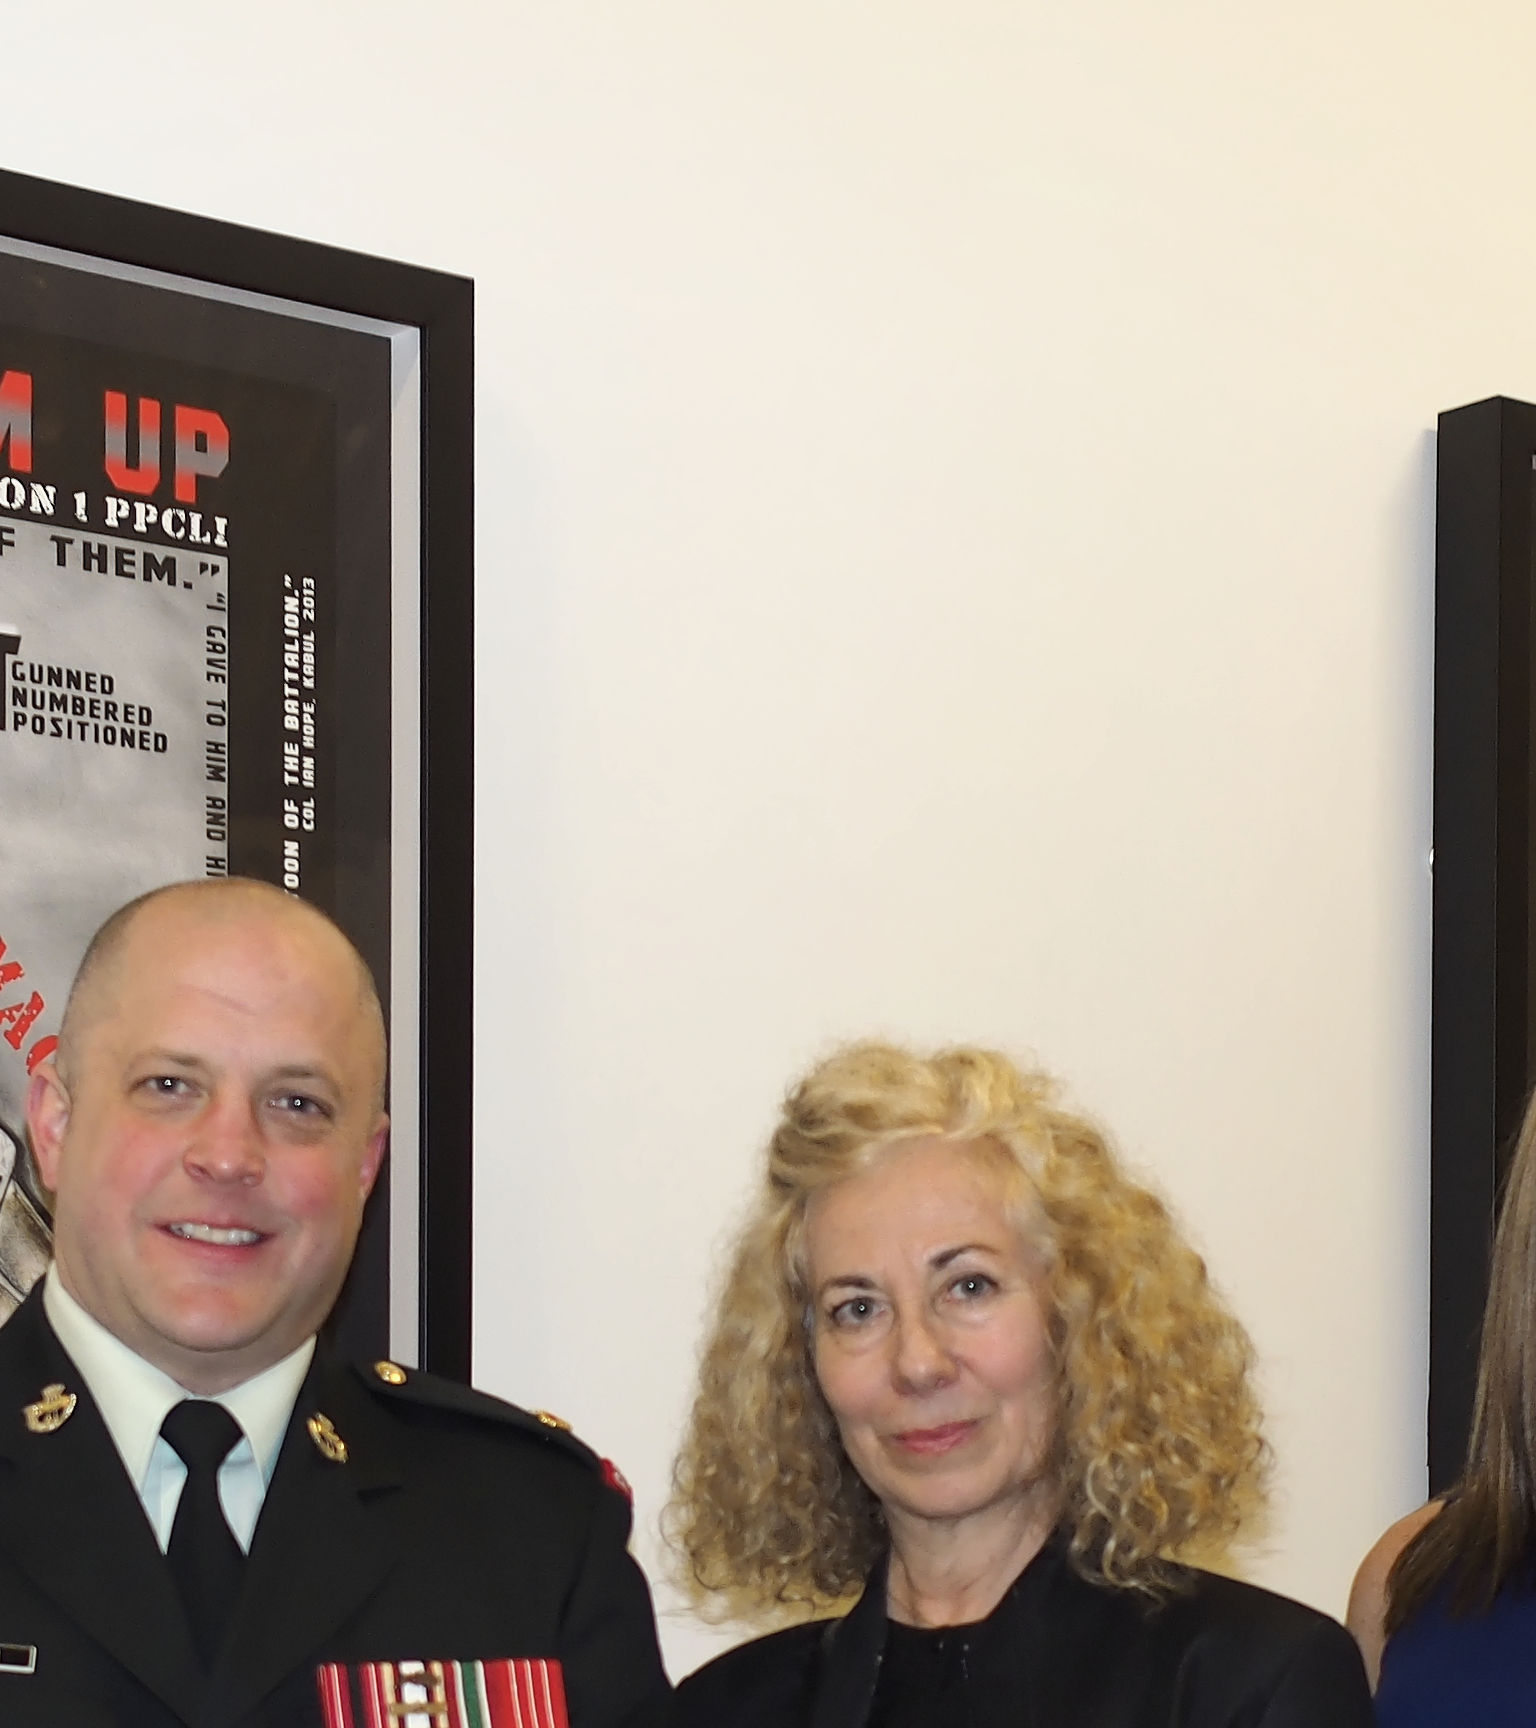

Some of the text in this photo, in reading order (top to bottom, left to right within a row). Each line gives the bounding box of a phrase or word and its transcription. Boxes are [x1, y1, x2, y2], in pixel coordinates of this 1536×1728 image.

[73, 491, 88, 523] 1
[104, 495, 228, 548] PPCLI
[205, 625, 226, 685] GAVE
[11, 660, 114, 696] GUNNED
[12, 685, 153, 728] NUMBERED
[205, 699, 226, 727] TO
[302, 576, 316, 830] COL IAN HOPE, KABUL 2013
[12, 712, 168, 754] POSITIONED
[204, 740, 226, 783] HIM
[283, 740, 300, 785] THE
[204, 795, 226, 842] AND
[283, 797, 299, 828] OF
